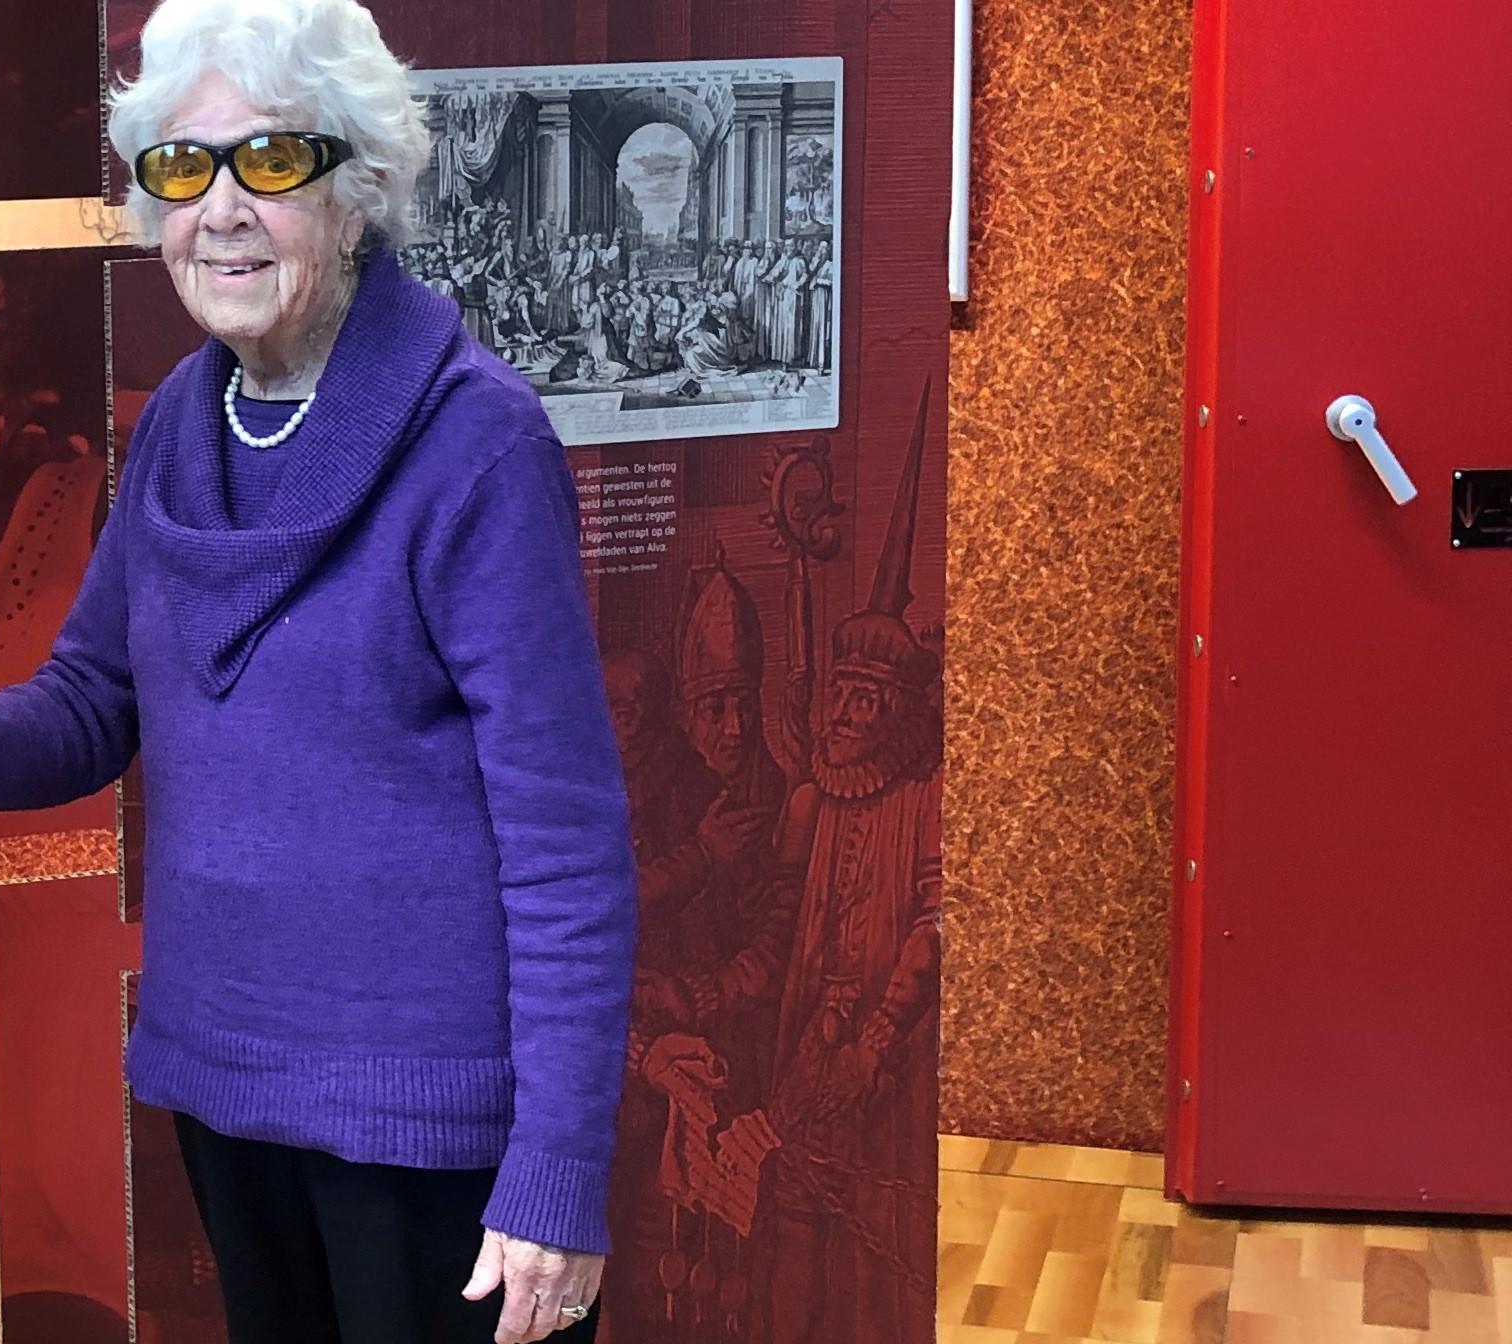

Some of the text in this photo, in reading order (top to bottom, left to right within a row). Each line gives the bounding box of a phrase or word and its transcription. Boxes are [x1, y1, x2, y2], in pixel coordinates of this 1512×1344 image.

[634, 463, 645, 473] De
[648, 462, 677, 474] hertog
[603, 481, 645, 494] gewesten
[647, 480, 659, 490] uit
[660, 478, 672, 488] de
[602, 497, 616, 508] als
[618, 494, 675, 507] vrouwfiguren
[589, 514, 619, 527] mogen
[621, 511, 643, 524] niets
[645, 510, 677, 523] zeggen
[585, 529, 613, 544] liggen
[615, 526, 649, 540] vertrapt
[651, 527, 663, 539] op
[664, 525, 676, 536] de
[629, 545, 645, 555] van
